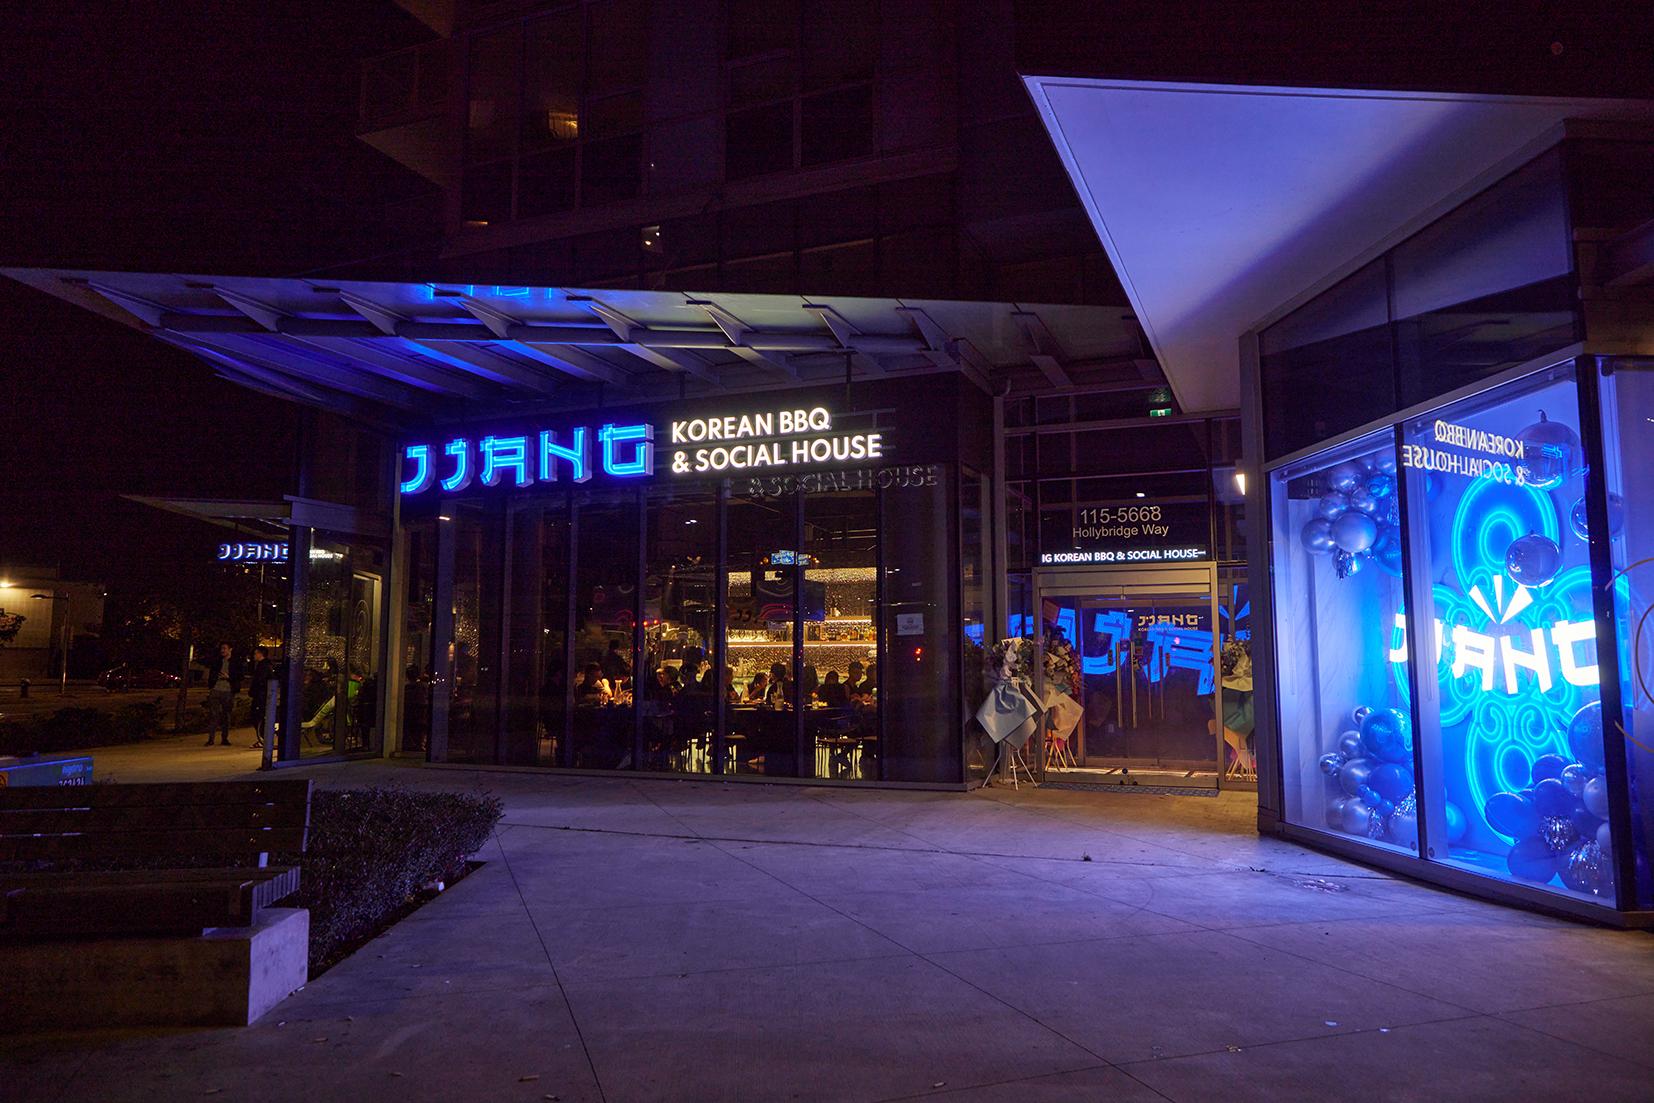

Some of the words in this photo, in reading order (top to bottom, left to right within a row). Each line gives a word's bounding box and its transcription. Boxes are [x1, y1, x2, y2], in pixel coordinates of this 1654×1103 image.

[672, 412, 774, 443] KOREAN
[779, 407, 832, 434] BBQ
[401, 423, 653, 494] JJANG
[672, 451, 692, 473] &
[695, 443, 788, 472] SOCIAL
[792, 434, 882, 464] HOUSE
[768, 470, 852, 497] SOCIAL
[858, 465, 939, 490] HOUSE
[1080, 506, 1162, 524] 115-5668
[1073, 526, 1138, 539] Hollybridge
[1142, 524, 1169, 537] Way
[1054, 552, 1092, 563] KOREAN
[1094, 551, 1115, 561] BBQ
[1116, 551, 1125, 560] &
[1127, 550, 1162, 560] SOCIAL
[1164, 549, 1198, 559] HOUSE
[1138, 614, 1198, 626] JJANG
